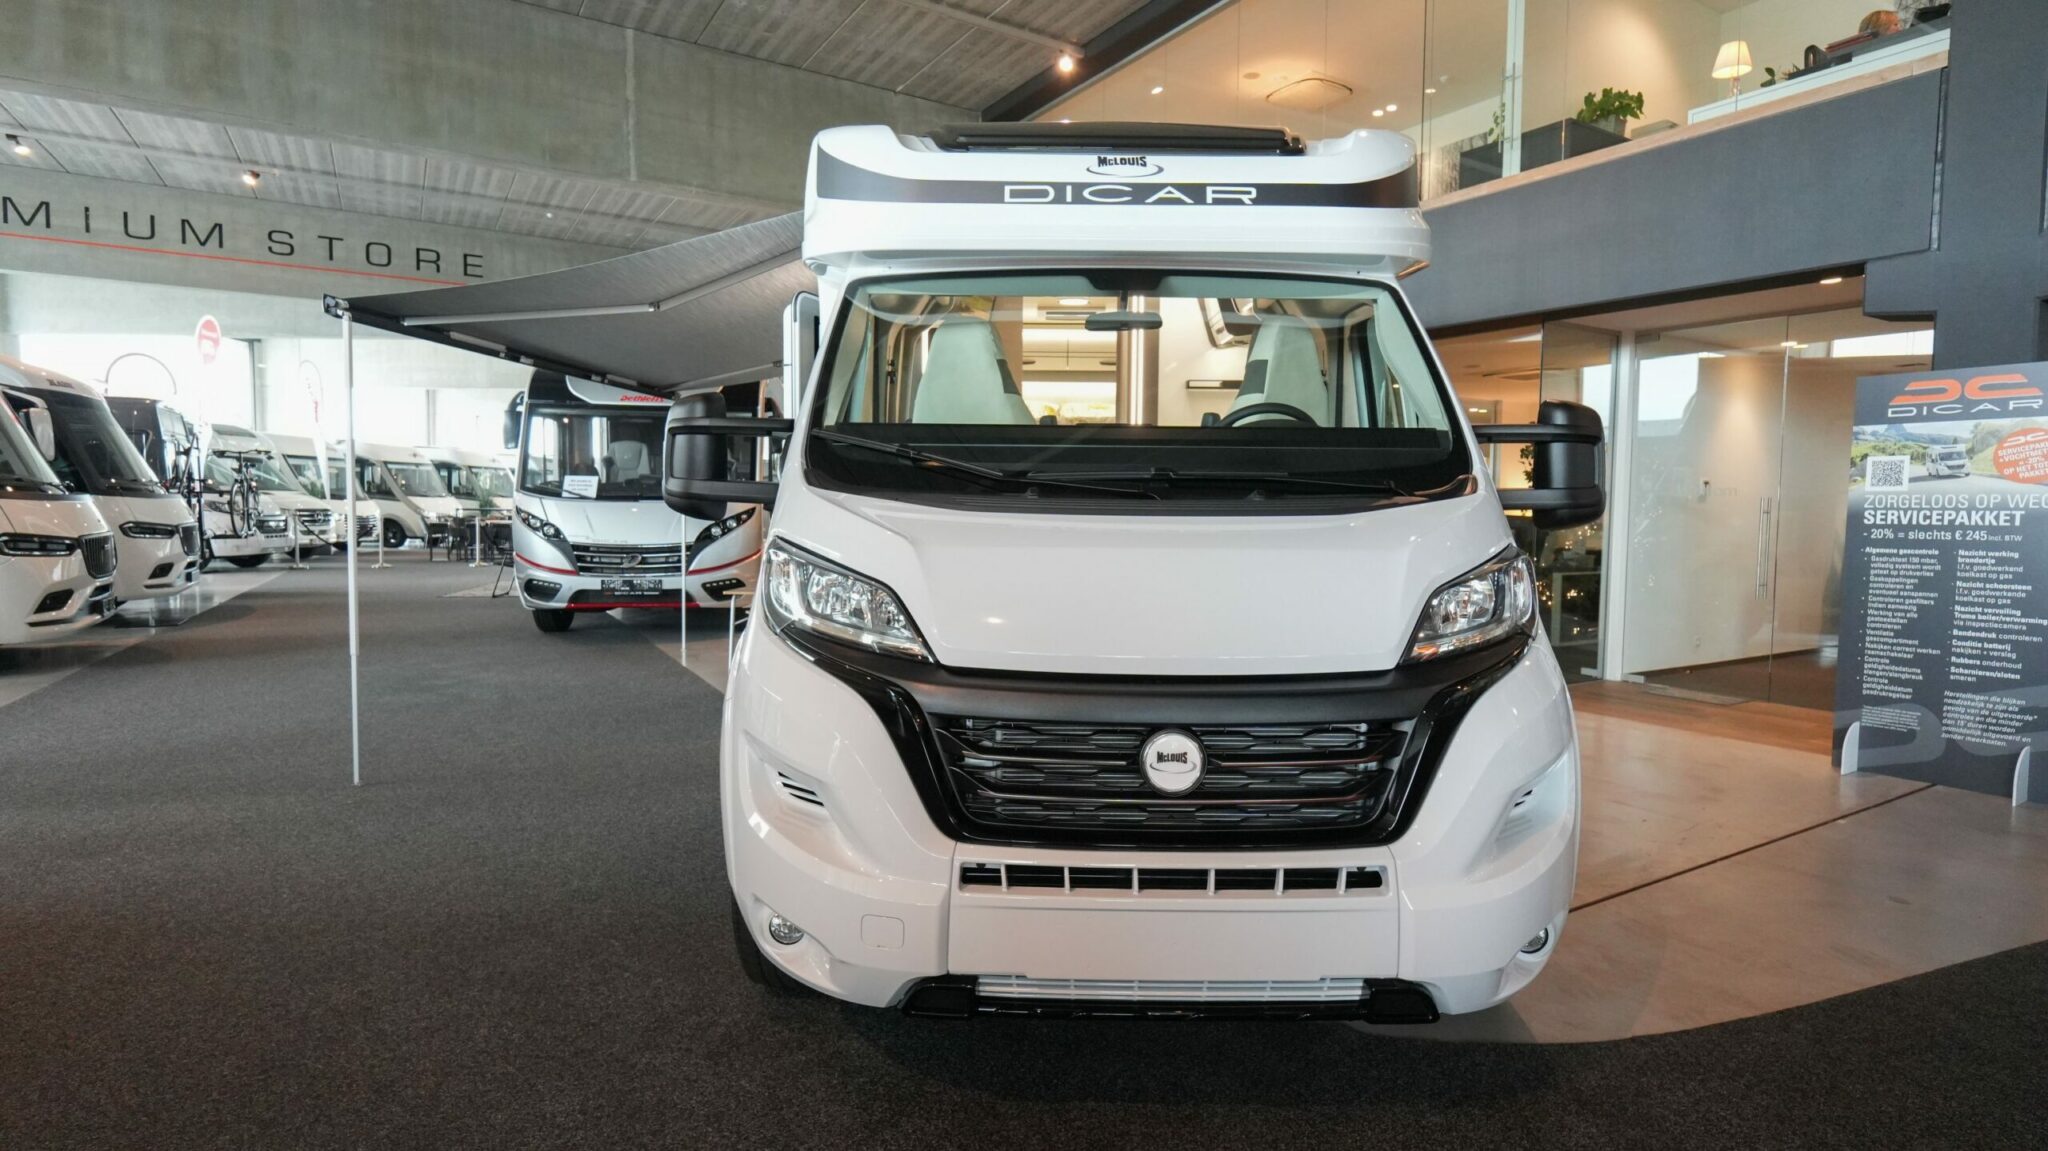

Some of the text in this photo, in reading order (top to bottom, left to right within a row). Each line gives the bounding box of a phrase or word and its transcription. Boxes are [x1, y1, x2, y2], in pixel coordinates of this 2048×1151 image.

[1004, 184, 1257, 204] DICAR
[2, 196, 484, 278] MIUM STORE
[1888, 399, 2044, 418] DICAR
[1864, 494, 1968, 509] ZORGELOOS
[1975, 494, 2001, 509] OP
[1864, 510, 2025, 526] SERVICEPAKKET
[1870, 529, 1894, 539] 20%
[1908, 529, 1951, 541] slechts
[1955, 530, 1962, 541] €
[1966, 530, 1987, 541] 245
[1988, 550, 2019, 558] werking
[1952, 639, 1982, 648] Conditie
[1999, 634, 2042, 642] controleren
[1989, 650, 2016, 659] verslag
[1982, 660, 2022, 669] onderhoud
